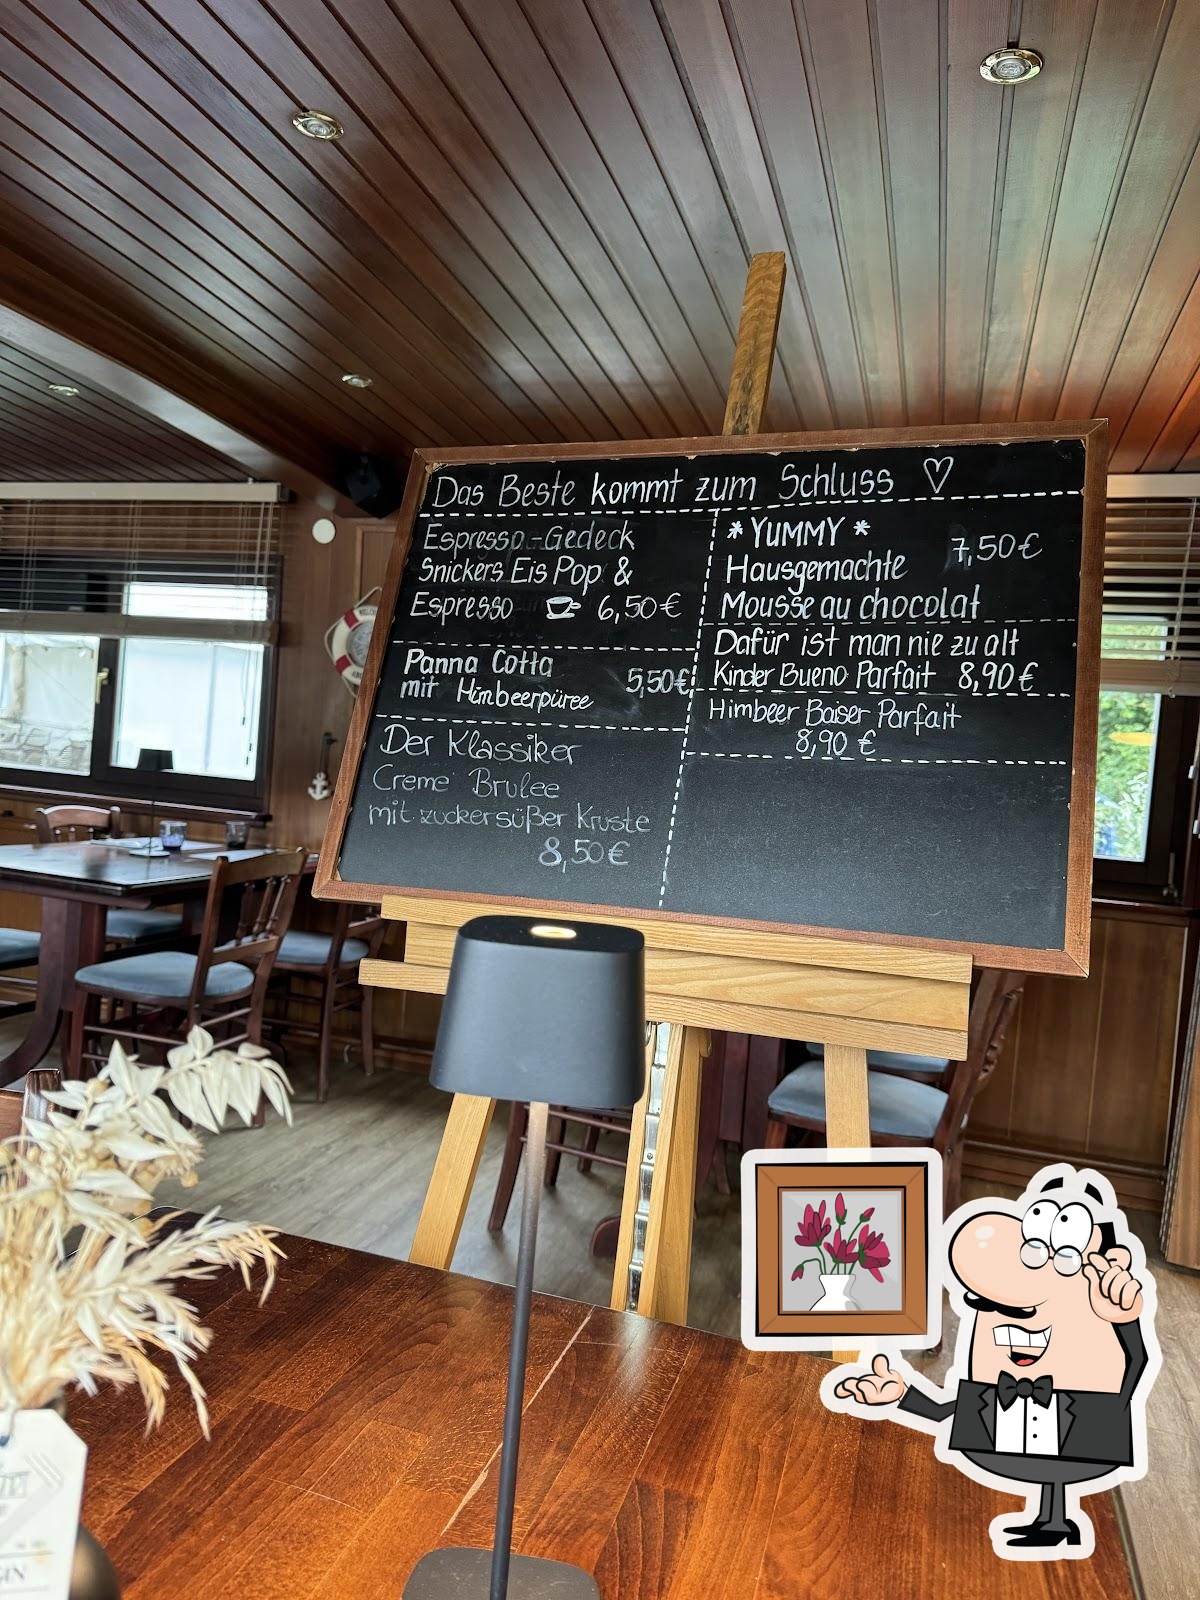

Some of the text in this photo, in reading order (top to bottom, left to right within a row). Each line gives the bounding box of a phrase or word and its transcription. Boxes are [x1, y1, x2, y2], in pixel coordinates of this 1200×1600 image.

[432, 462, 895, 508] Das Beste kommt zum Schluss
[750, 516, 846, 549] YUMMY
[951, 532, 1042, 566] 7,50€
[418, 555, 633, 596] Snickers Eis Pop &
[726, 549, 910, 595] Hausgemachte
[410, 591, 682, 626] Espresso 6,50€
[721, 584, 981, 620] Mousse au chocolat
[714, 626, 1019, 657] Dafür ist man nie zu alt
[403, 648, 691, 698] Panna Cotta 5,50€
[712, 659, 775, 688] Kinder
[779, 662, 849, 688] Bueno
[855, 660, 936, 691] Parfait
[400, 674, 594, 713] mit Himbeerpüree
[708, 699, 962, 736] Himbeer Baiser Parfait
[380, 724, 584, 766] Der Klassiker
[372, 763, 561, 798] Creme Brulee
[369, 800, 415, 825] mit
[577, 802, 651, 833] Kruste
[538, 836, 631, 873] 8,50€
